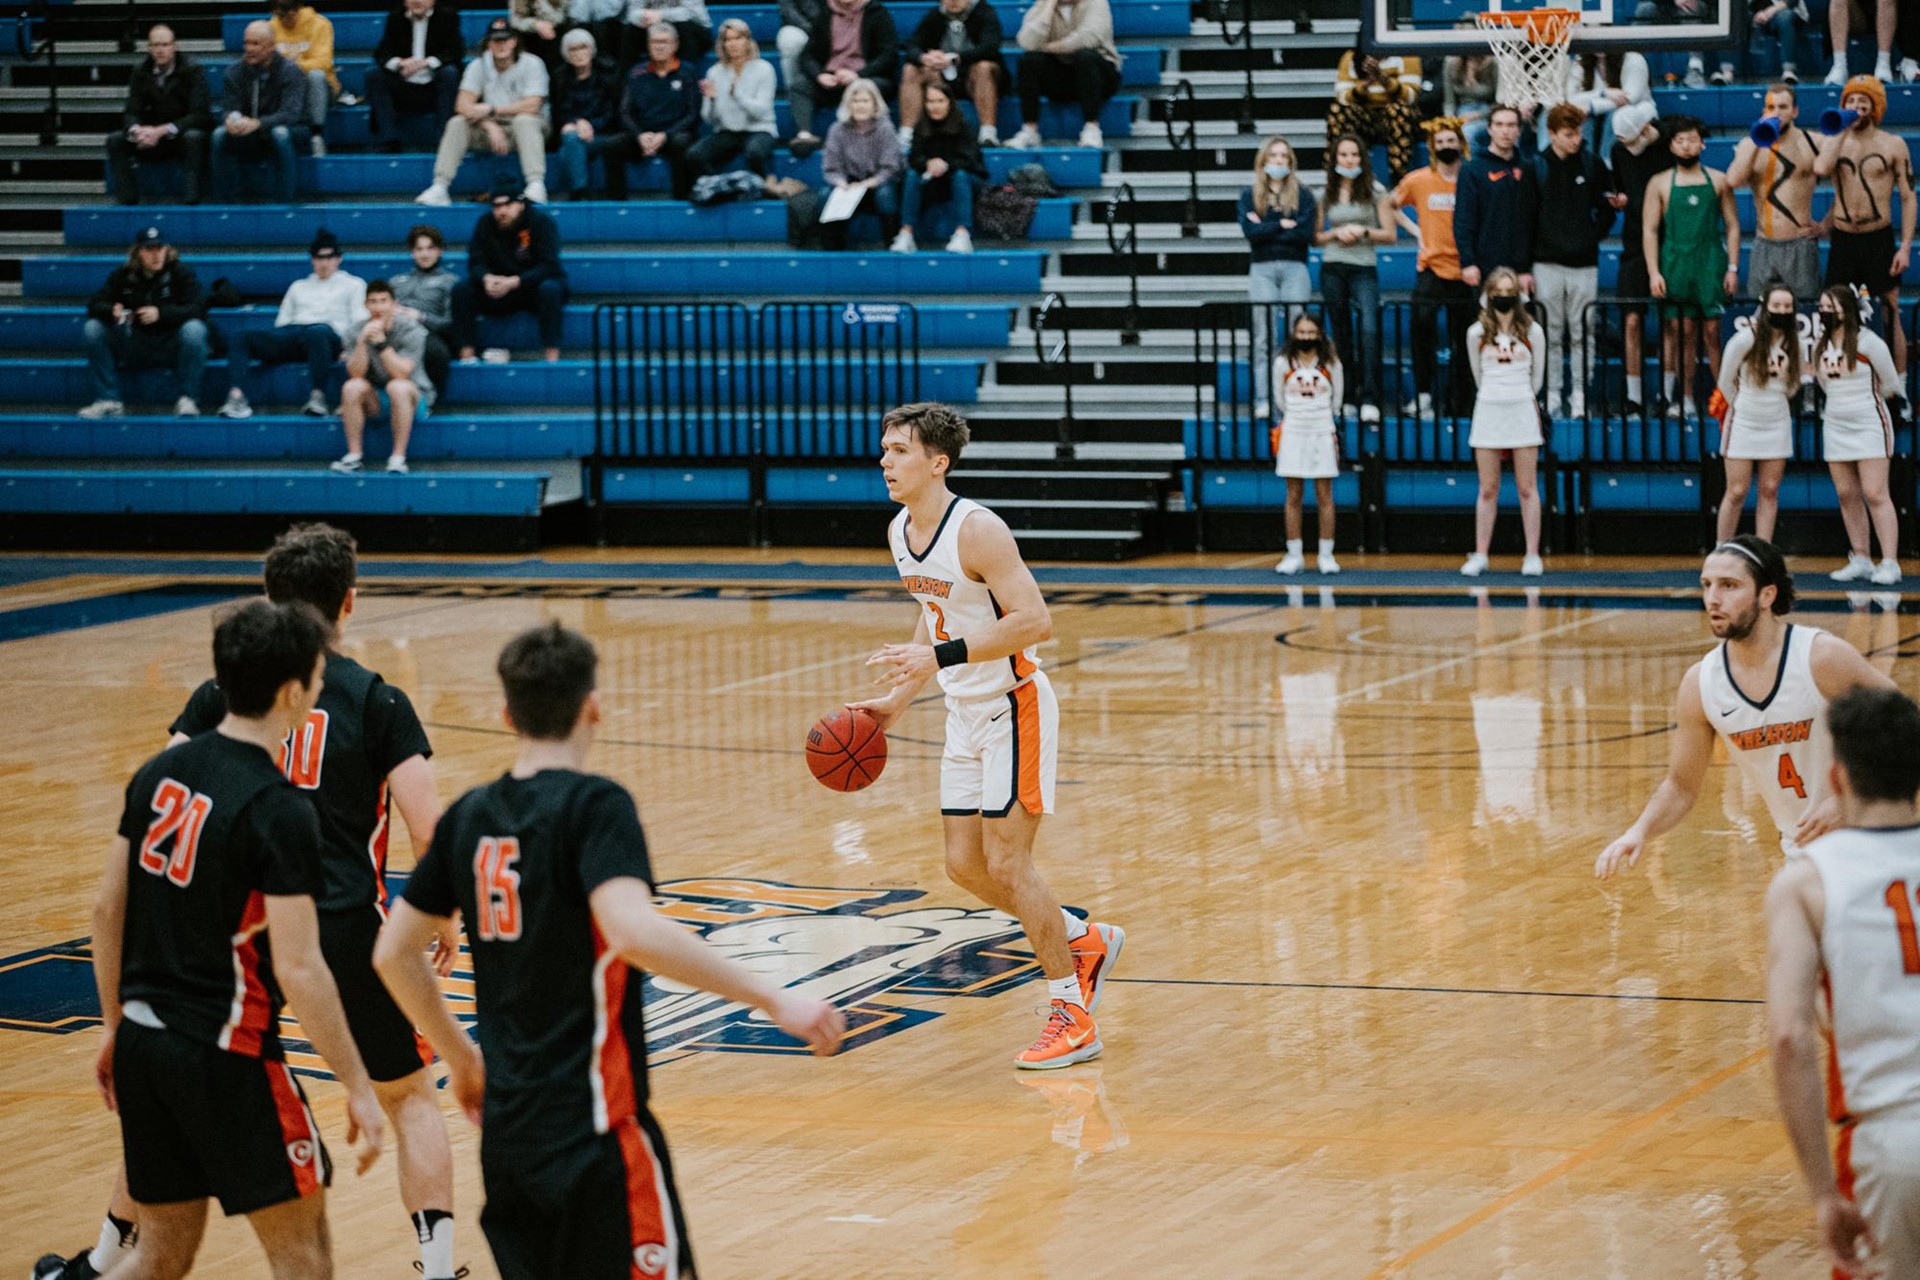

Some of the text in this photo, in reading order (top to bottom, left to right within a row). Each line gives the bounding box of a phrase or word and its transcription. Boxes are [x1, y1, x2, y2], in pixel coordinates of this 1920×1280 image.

[927, 601, 951, 641] 2
[1778, 752, 1808, 799] 4
[139, 776, 214, 889] 20
[472, 836, 523, 942] 15
[1884, 878, 1920, 976] 1
